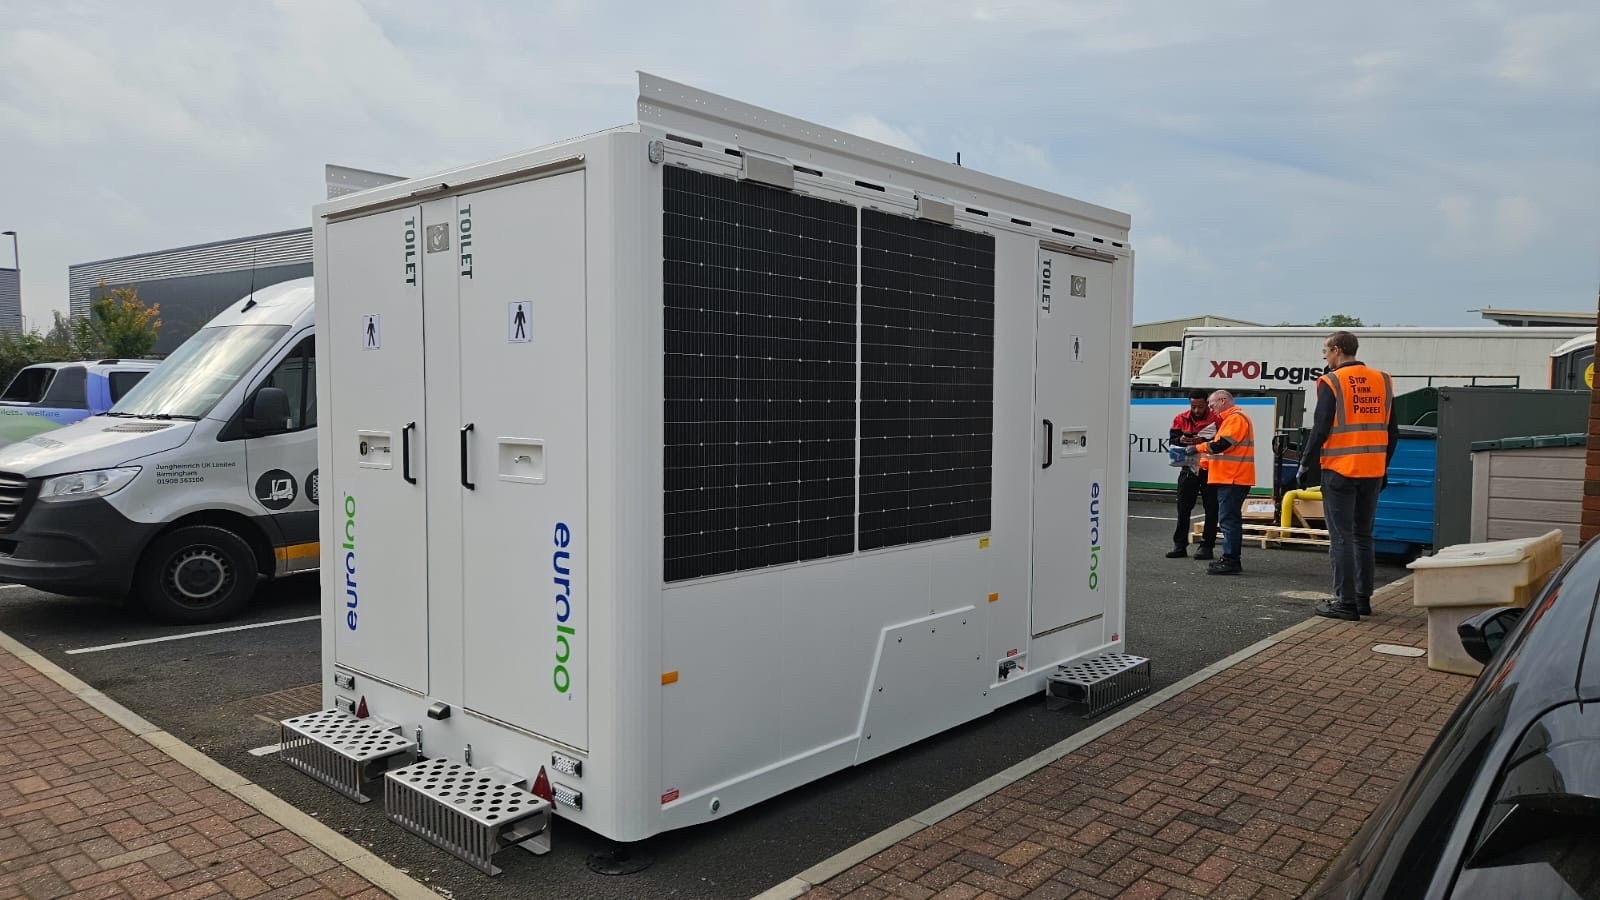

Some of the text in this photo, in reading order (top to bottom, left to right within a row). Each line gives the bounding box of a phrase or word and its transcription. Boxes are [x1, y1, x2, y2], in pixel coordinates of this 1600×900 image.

[405, 216, 416, 286] TOILET
[460, 203, 472, 279] TOILET
[1042, 259, 1052, 314] TOILET
[1348, 375, 1367, 384] STOP
